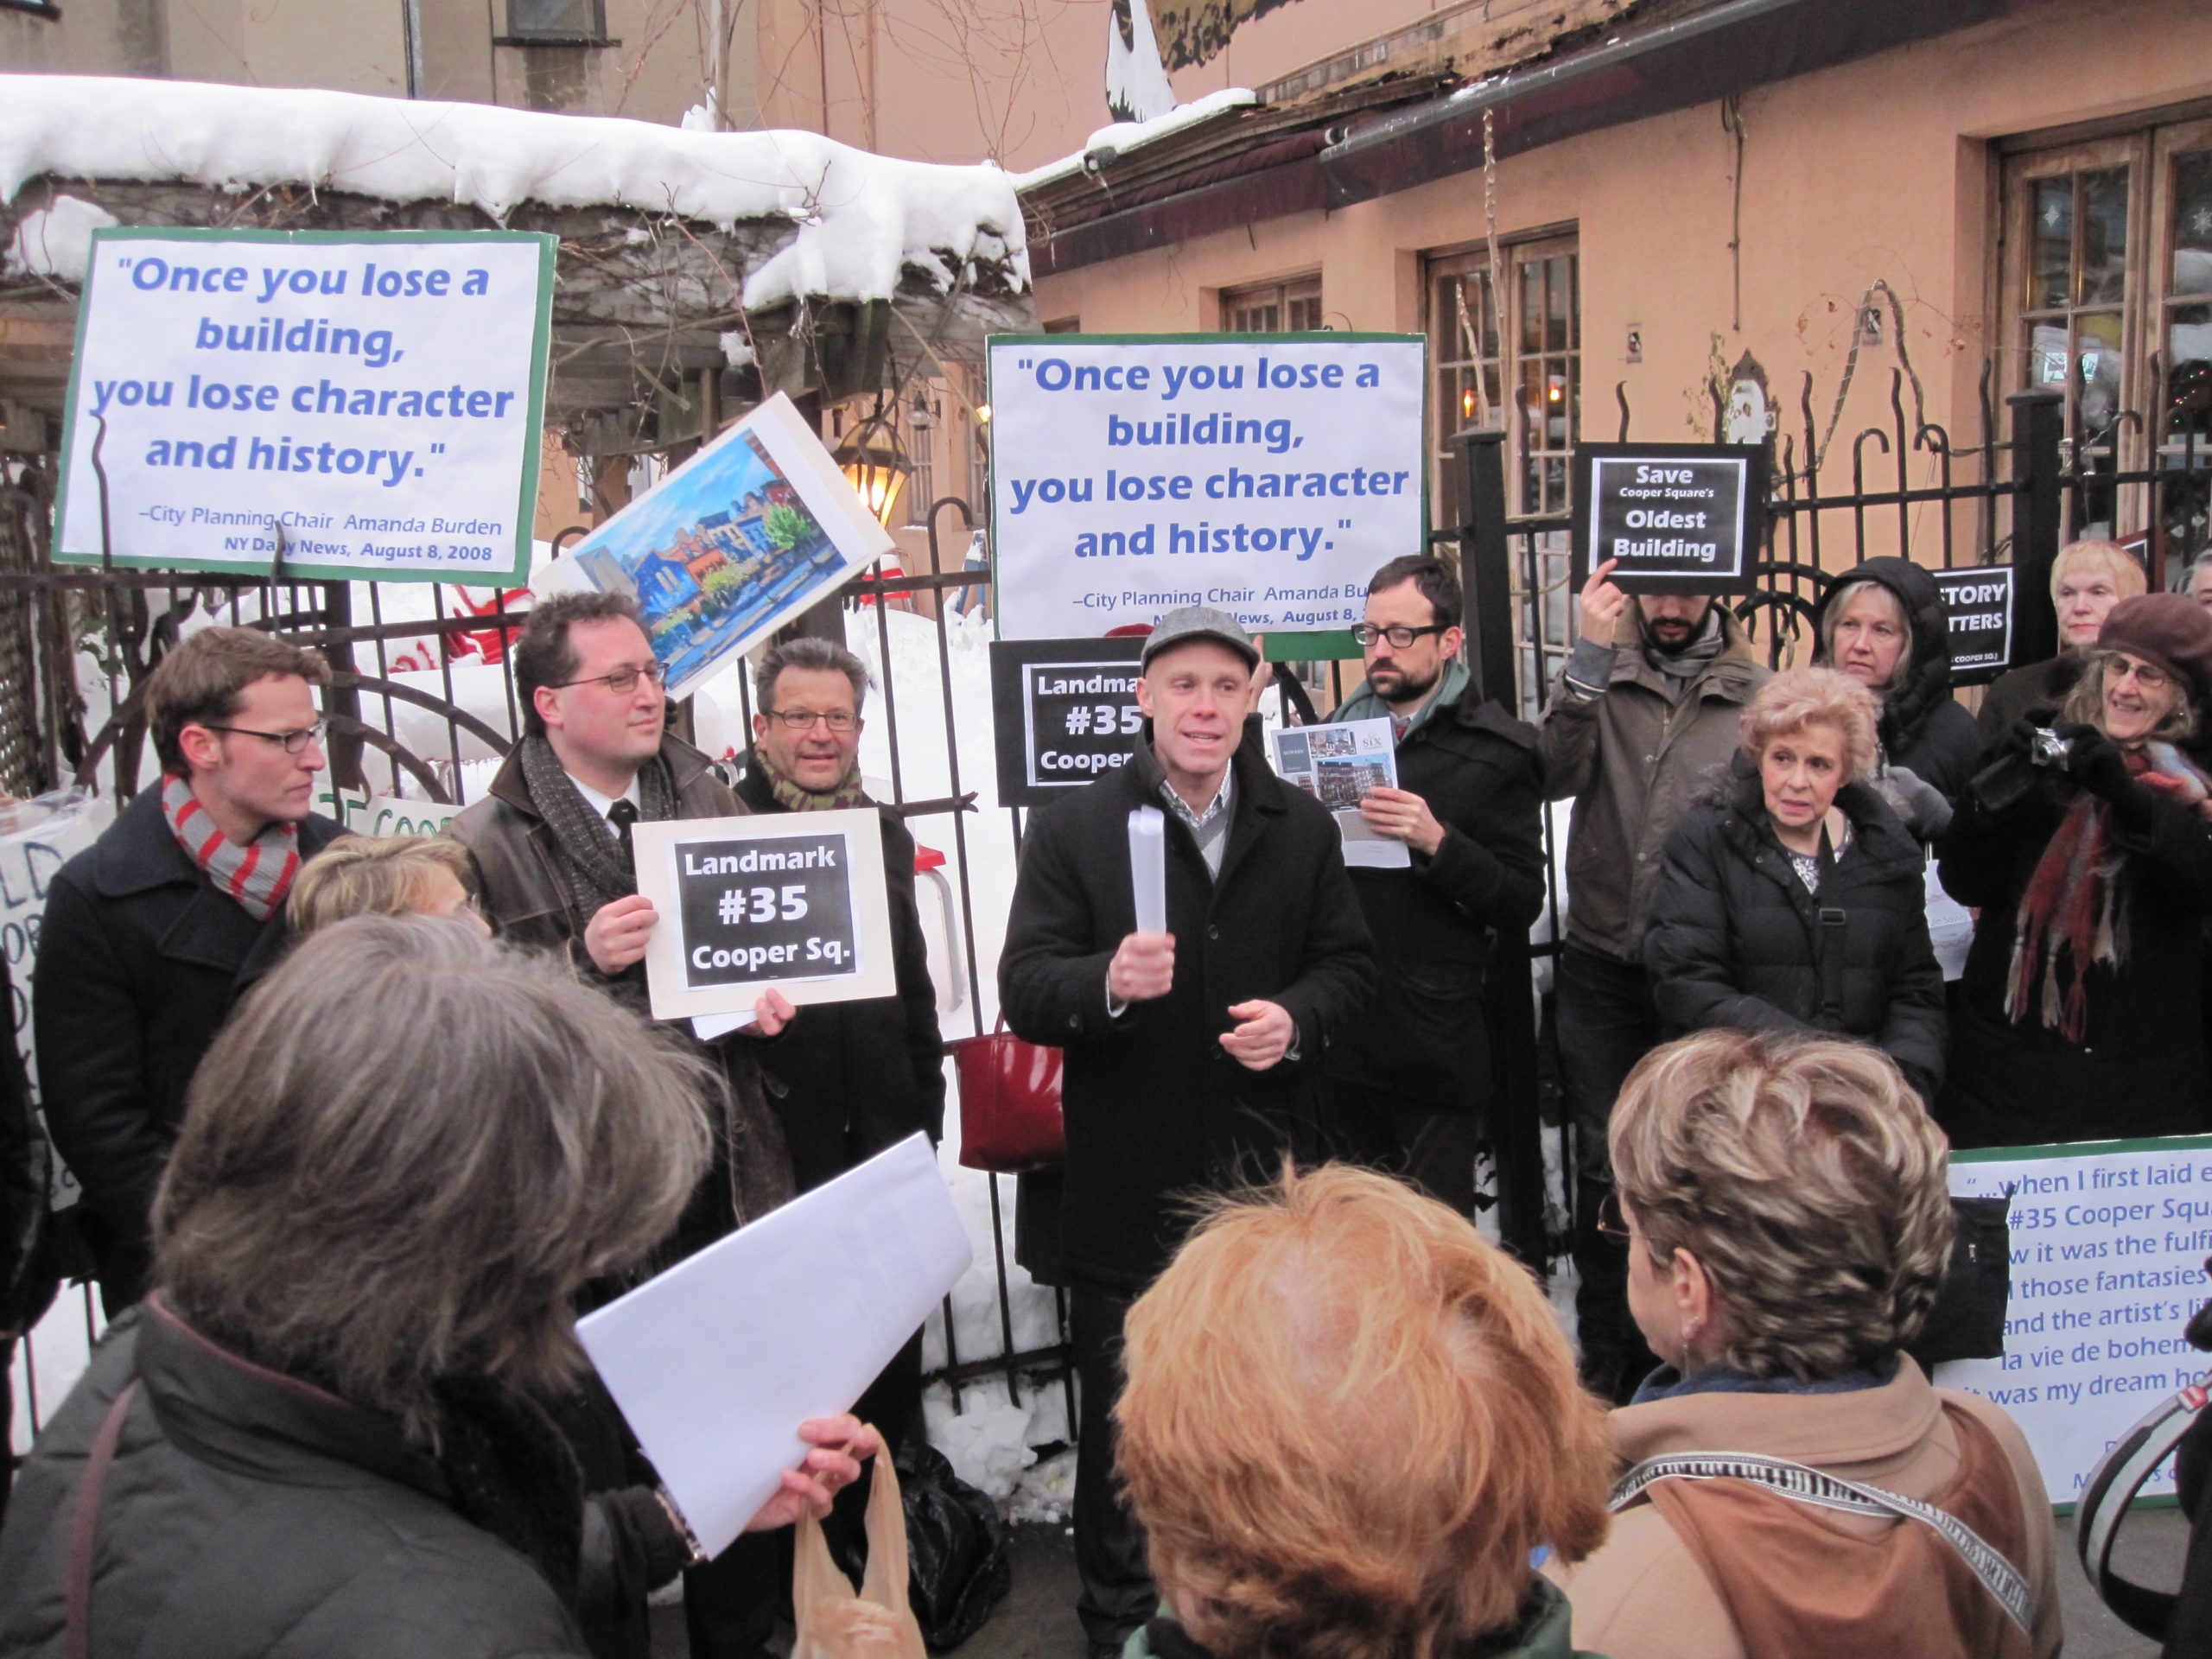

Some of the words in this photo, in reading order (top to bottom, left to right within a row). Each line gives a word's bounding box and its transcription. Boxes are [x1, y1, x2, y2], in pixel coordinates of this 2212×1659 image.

[118, 257, 249, 292] "Once
[256, 268, 346, 302] you
[361, 263, 451, 297] lose
[461, 268, 489, 296] a
[195, 317, 405, 368] building,
[1018, 359, 1150, 391] "Once
[1160, 365, 1244, 400] you
[1257, 358, 1344, 390] lose
[1356, 364, 1380, 387] a
[89, 379, 174, 416] you
[188, 375, 280, 411] lose
[290, 378, 515, 418] character
[1107, 413, 1305, 454] building,
[145, 436, 237, 470] and
[248, 437, 445, 488] history."
[1636, 466, 1694, 484] Save
[1009, 478, 1094, 514] you
[1105, 470, 1193, 501] lose
[1205, 467, 1409, 499] character
[1619, 487, 1662, 499] Cooper
[1664, 487, 1714, 499] Square's
[192, 507, 276, 531] Planning
[281, 512, 334, 530] Chair
[343, 514, 425, 533] Amanda
[432, 518, 502, 536] Burden
[1626, 510, 1707, 528] Oldest
[224, 537, 249, 550] NY
[301, 541, 351, 557] News,
[359, 543, 423, 562] August
[427, 545, 442, 560] 8,
[448, 545, 493, 561] 2008
[1074, 524, 1156, 558] and
[1168, 519, 1352, 562] history."
[1613, 539, 1716, 563] Building
[1122, 589, 1203, 607] Planning
[1207, 588, 1255, 602] Chair
[1264, 586, 1338, 601] Amanda
[1282, 609, 1339, 626] August
[1344, 609, 1357, 622] 8,
[1955, 654, 1983, 663] COOPER
[1065, 705, 1142, 735] #35
[684, 845, 836, 875] Landmark
[719, 885, 809, 925] #35
[692, 944, 798, 972] Cooper
[805, 937, 850, 965] Sq.
[2093, 1166, 2139, 1190] first
[2147, 1163, 2191, 1185] laid
[2010, 1208, 2056, 1230] #35
[2065, 1203, 2155, 1228] Cooper
[2037, 1243, 2053, 1263] it
[2061, 1241, 2108, 1261] was
[2115, 1235, 2157, 1255] the
[2021, 1277, 2088, 1300] those
[2096, 1266, 2207, 1292] fantasies
[2003, 1313, 2044, 1336] and
[2052, 1310, 2092, 1331] the
[2001, 1351, 2023, 1370] la
[2031, 1346, 2064, 1368] vie
[2071, 1343, 2101, 1363] de
[1988, 1386, 2037, 1404] was
[2047, 1382, 2082, 1405] my
[2089, 1373, 2166, 1396] dream
